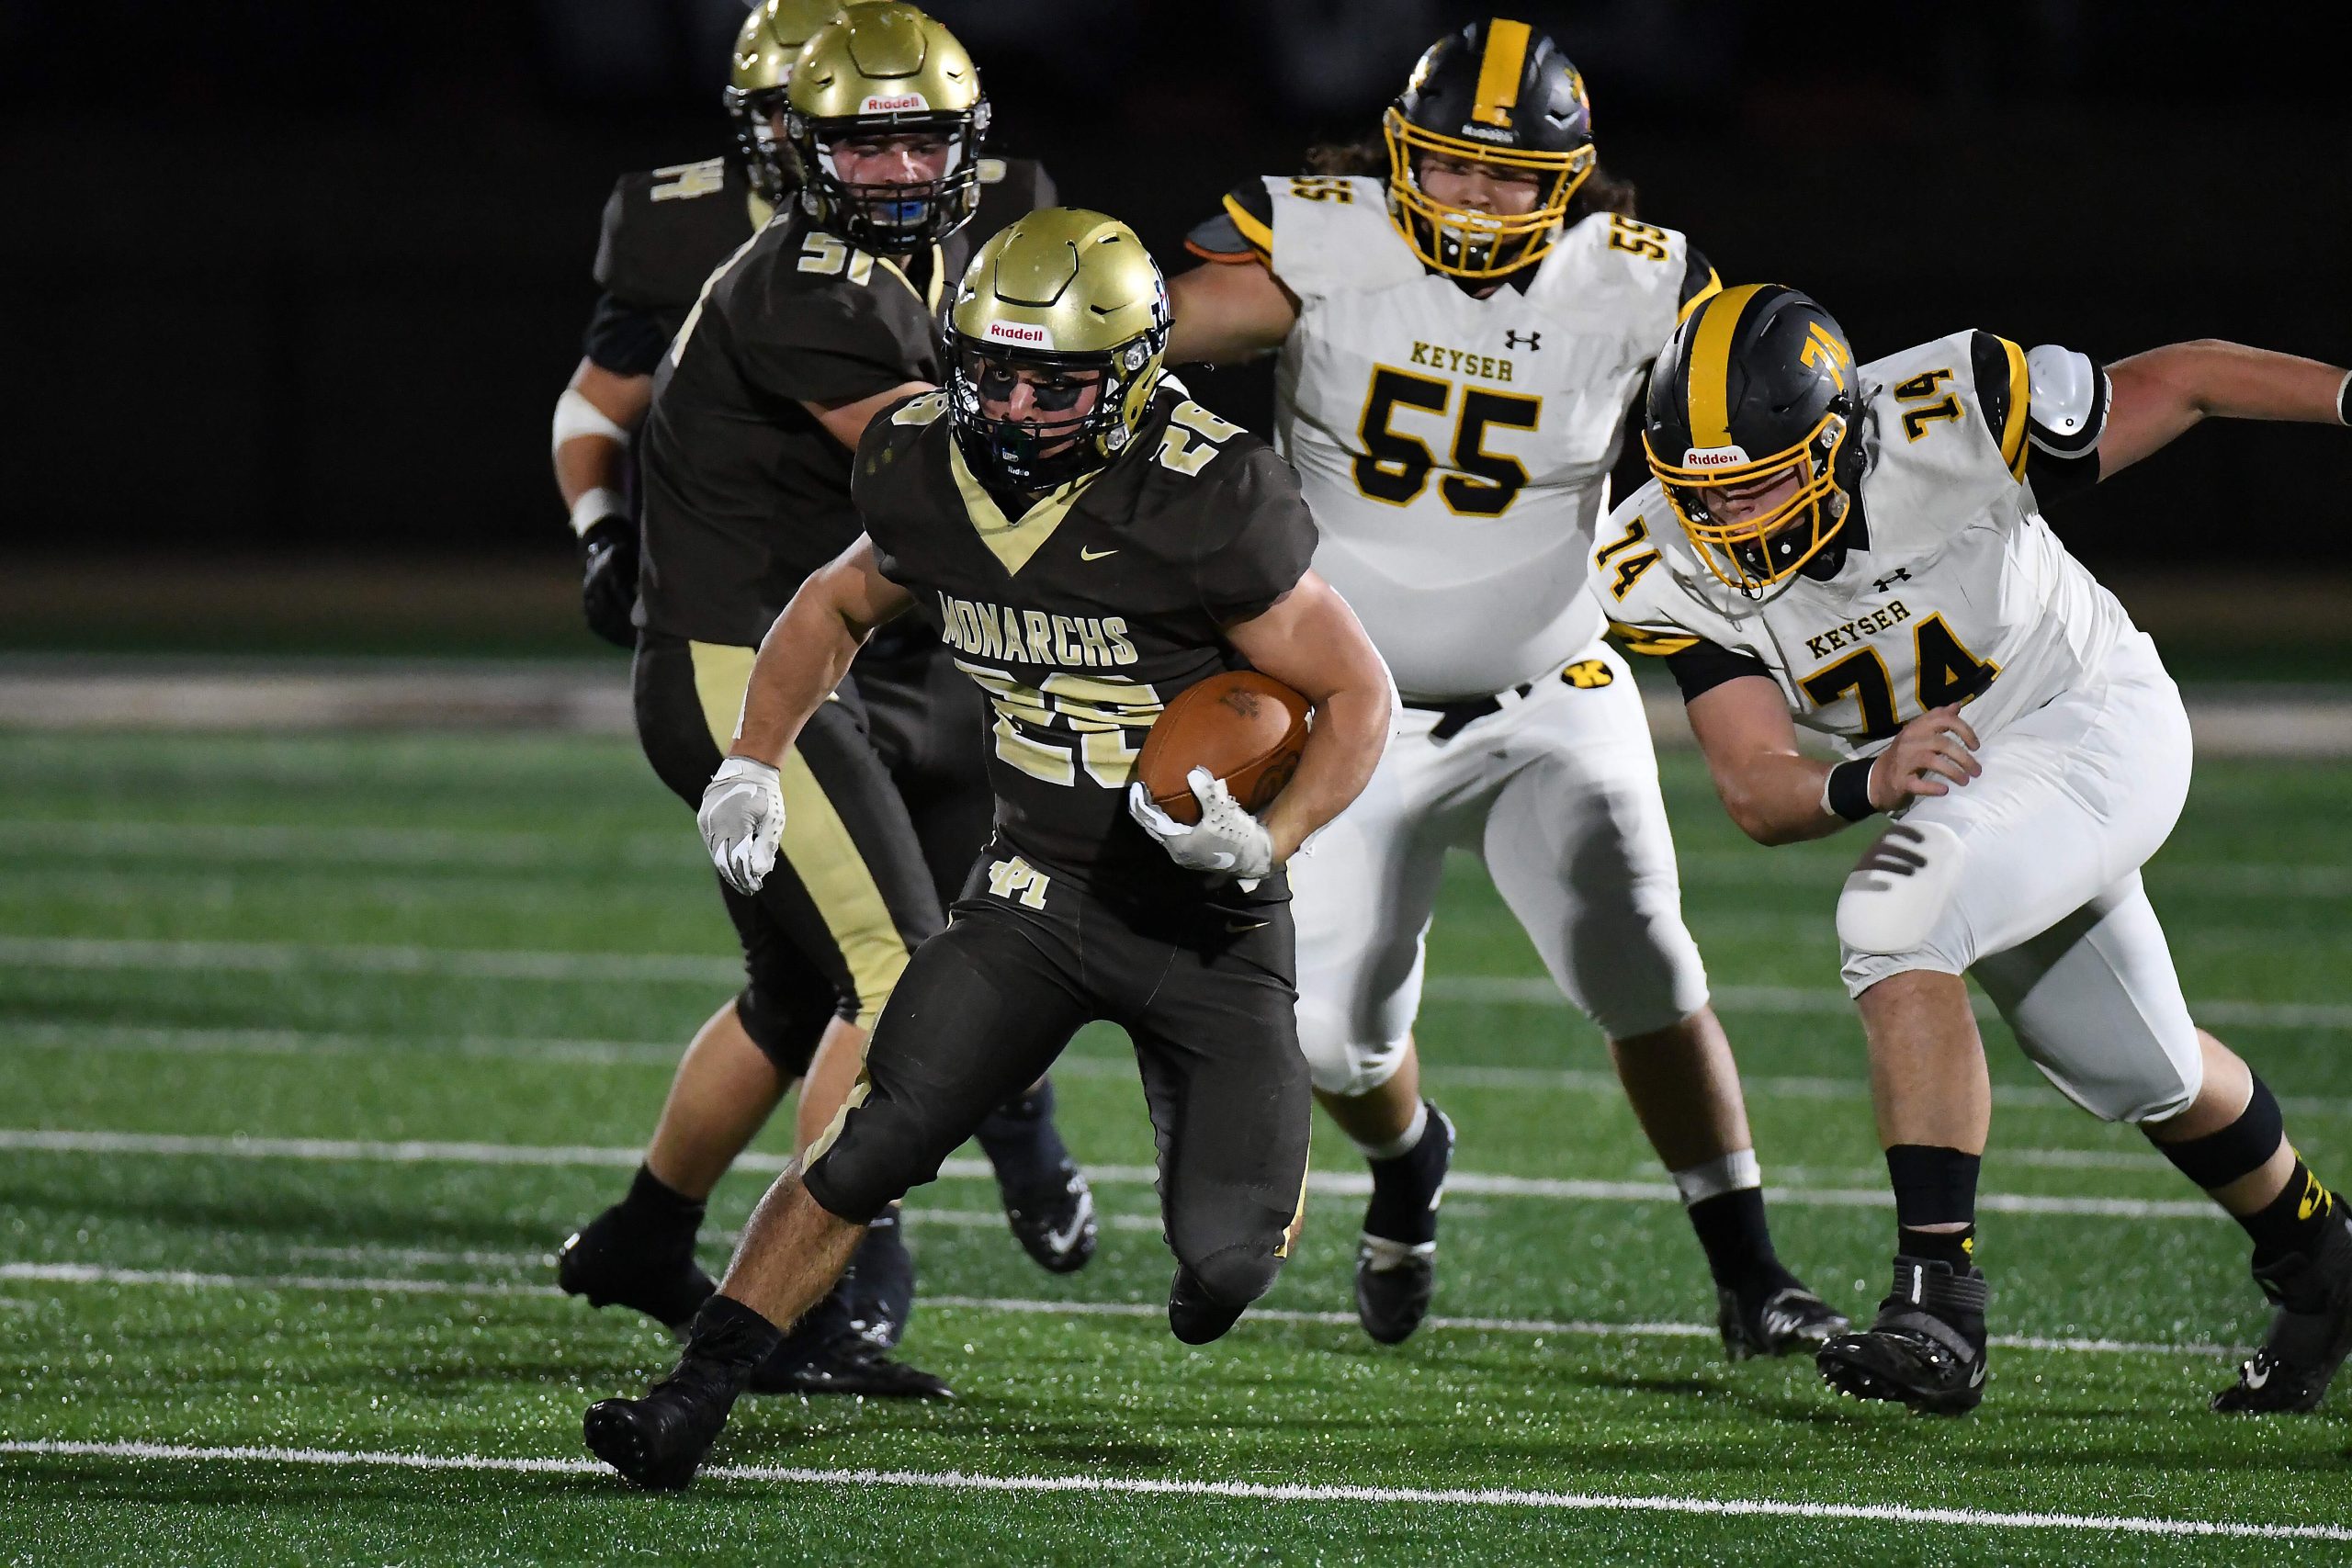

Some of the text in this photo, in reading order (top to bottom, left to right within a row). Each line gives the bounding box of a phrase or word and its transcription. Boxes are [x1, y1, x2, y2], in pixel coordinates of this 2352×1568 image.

[990, 323, 1044, 342] Riddell
[1409, 340, 1513, 382] KEYSER
[1351, 362, 1544, 519] 55
[1893, 367, 1967, 445] 74
[1593, 513, 1664, 604] 74
[937, 590, 1139, 666] MONARCHS
[1804, 599, 1912, 660] KEYSER
[1796, 610, 2005, 741] 74
